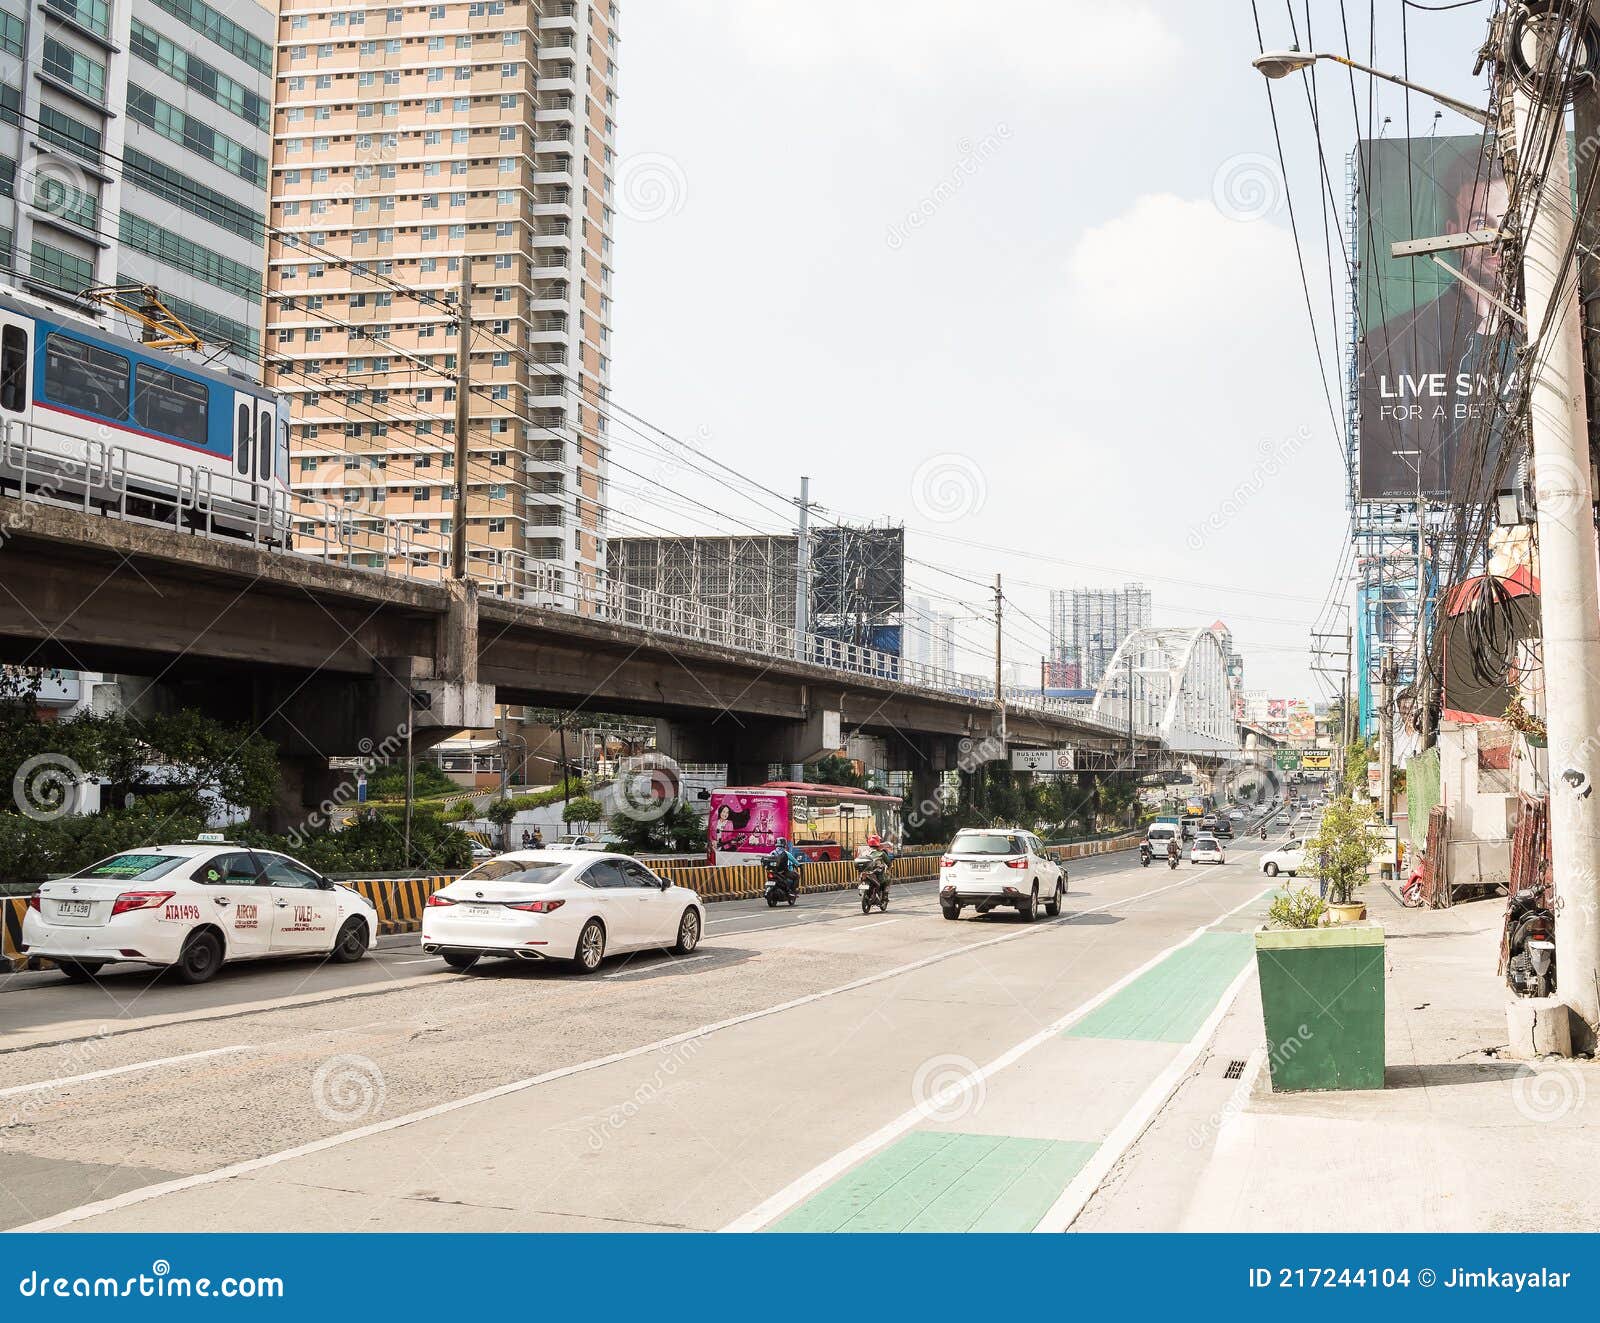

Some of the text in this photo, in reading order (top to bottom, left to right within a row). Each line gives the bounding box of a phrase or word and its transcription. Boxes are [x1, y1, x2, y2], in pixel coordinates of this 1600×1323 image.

[1380, 373, 1448, 398] LIVE
[1380, 404, 1423, 421] FOR
[1432, 406, 1447, 421] A
[165, 904, 200, 920] ATA1498
[235, 904, 258, 919] AIRCON
[294, 905, 313, 922] YULEI
